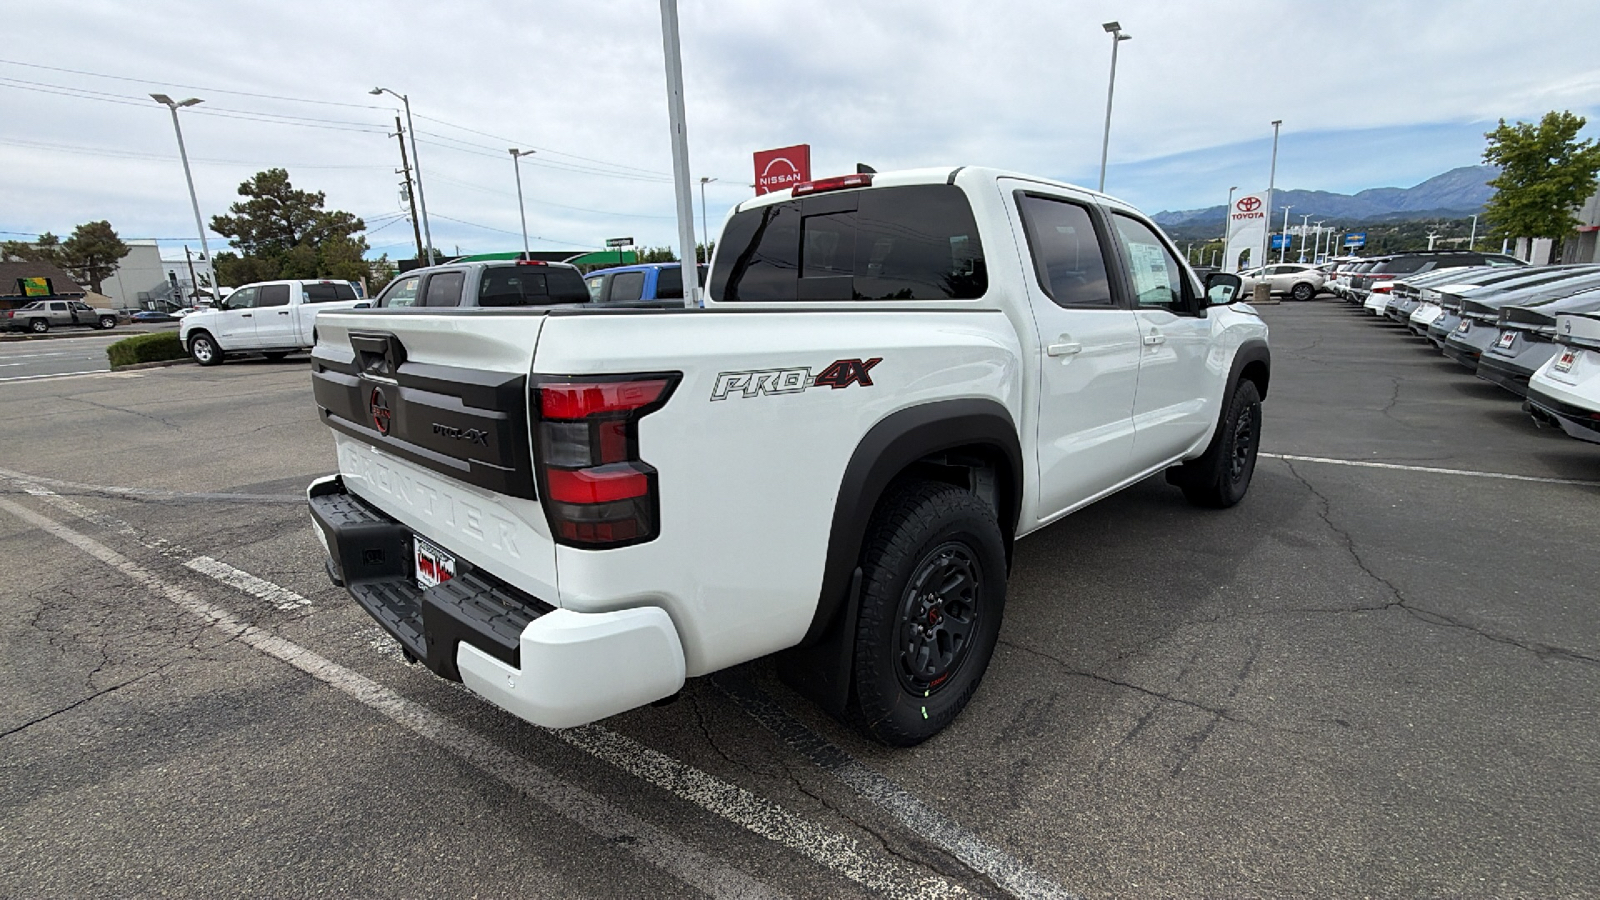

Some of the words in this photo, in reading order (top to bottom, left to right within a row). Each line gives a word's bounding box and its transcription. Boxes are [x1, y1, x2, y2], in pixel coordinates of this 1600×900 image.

[760, 173, 801, 185] NISSAN
[1232, 212, 1264, 220] TOYOTA
[710, 357, 883, 401] PRO-4X
[346, 447, 521, 559] FRONTIER
